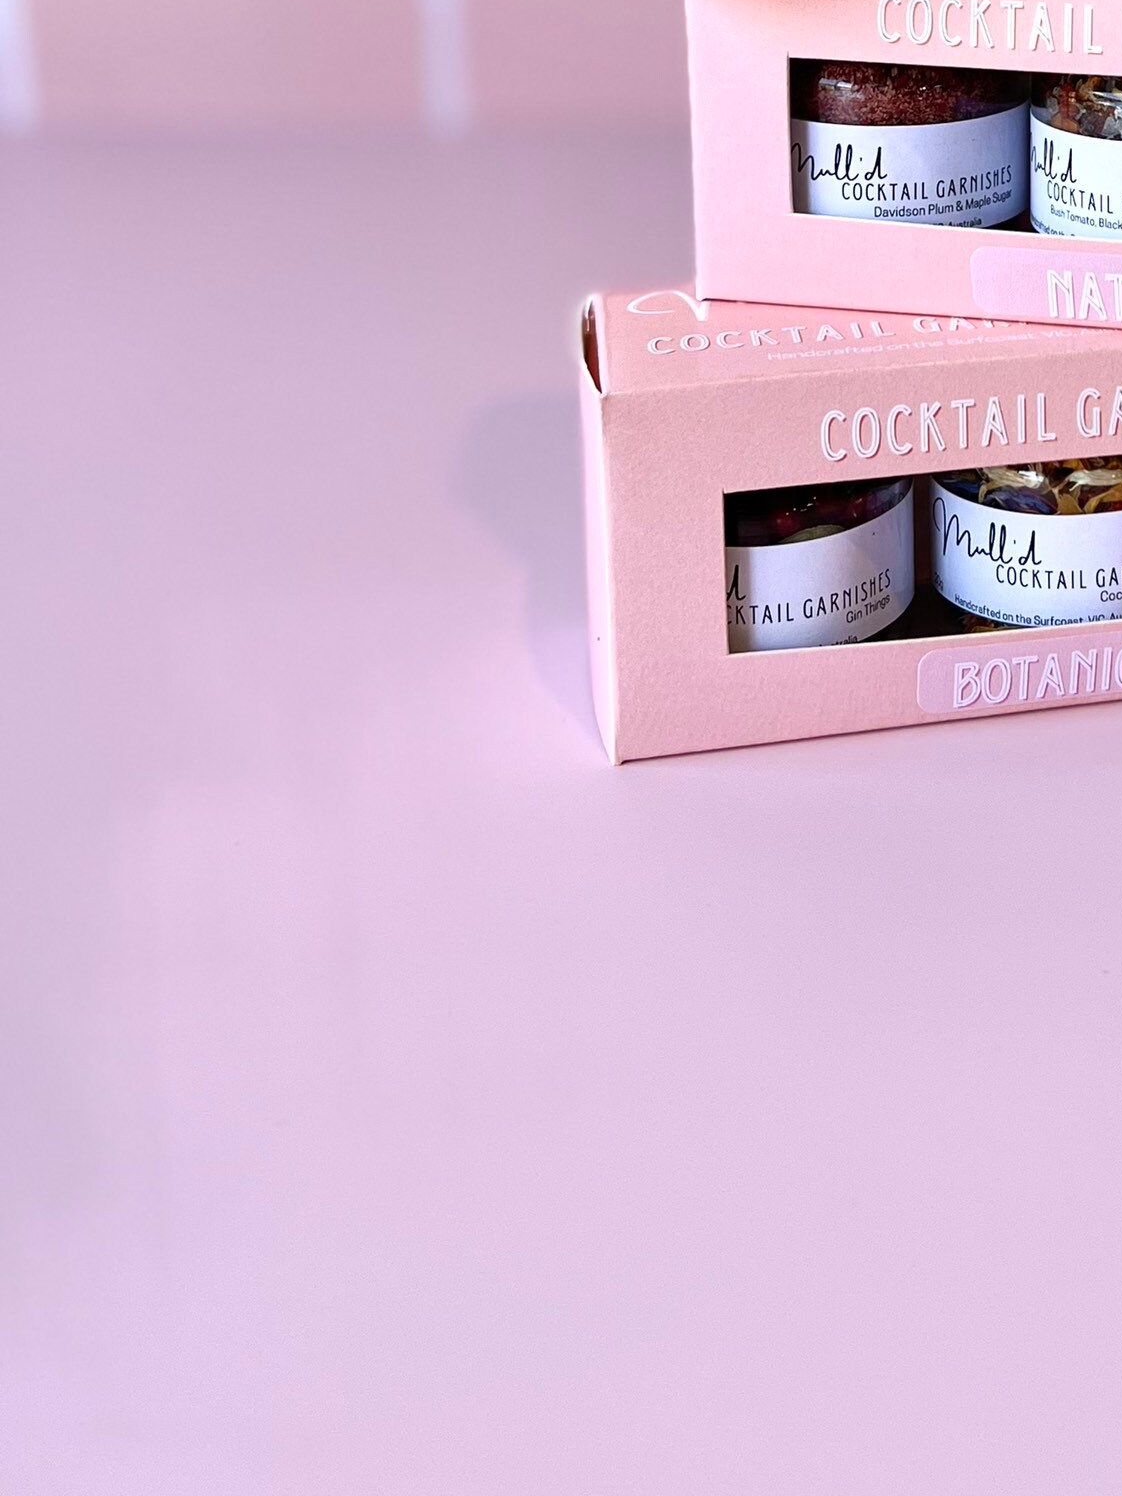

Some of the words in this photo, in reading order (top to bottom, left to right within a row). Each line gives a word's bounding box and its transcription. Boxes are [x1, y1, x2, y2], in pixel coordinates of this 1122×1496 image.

[841, 181, 928, 201] COCKTAIL
[936, 164, 1012, 198] GARNISHES
[1047, 180, 1113, 215] COCKTAIL
[874, 204, 926, 218] Davidson
[928, 202, 954, 216] Plum
[955, 200, 964, 212] &
[965, 196, 991, 210] Maple
[992, 188, 1012, 203] Sugar
[1099, 217, 1122, 230] Black
[647, 320, 896, 354] COCKTAIL
[767, 341, 885, 361] Handcrafted
[887, 343, 908, 351] on
[820, 392, 1057, 461] COCKTAIL
[932, 497, 1042, 565] Mull'd
[996, 564, 1087, 589] COCKTAIL
[803, 568, 891, 619] GARNISHES
[846, 608, 863, 624] Gin
[864, 595, 891, 616] Things
[954, 593, 1001, 619] Handcrafted
[1002, 614, 1014, 622] on
[1016, 613, 1032, 624] the
